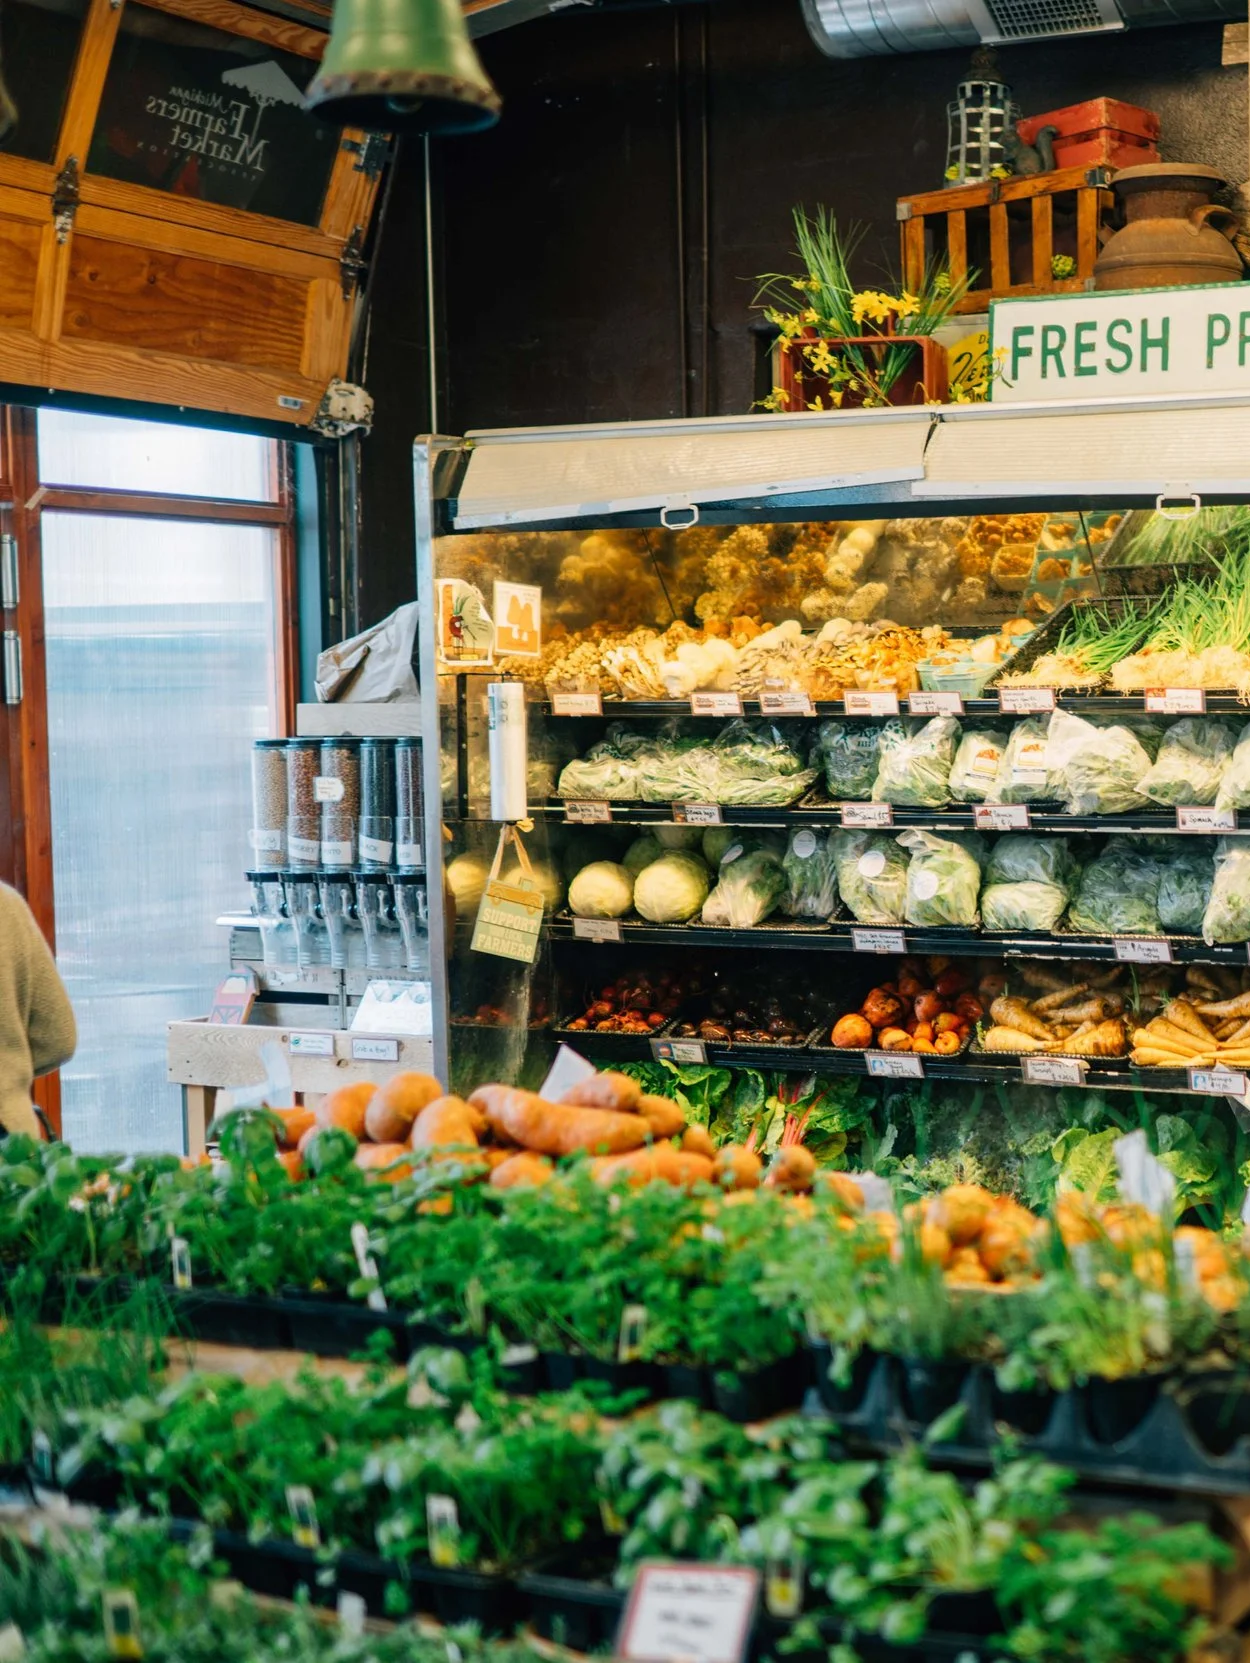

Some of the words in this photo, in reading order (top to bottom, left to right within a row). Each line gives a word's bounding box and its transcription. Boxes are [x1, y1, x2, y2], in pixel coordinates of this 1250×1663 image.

[1011, 315, 1170, 381] FRESH
[482, 908, 537, 933] SUPPORT
[476, 933, 533, 960] FARMERS
